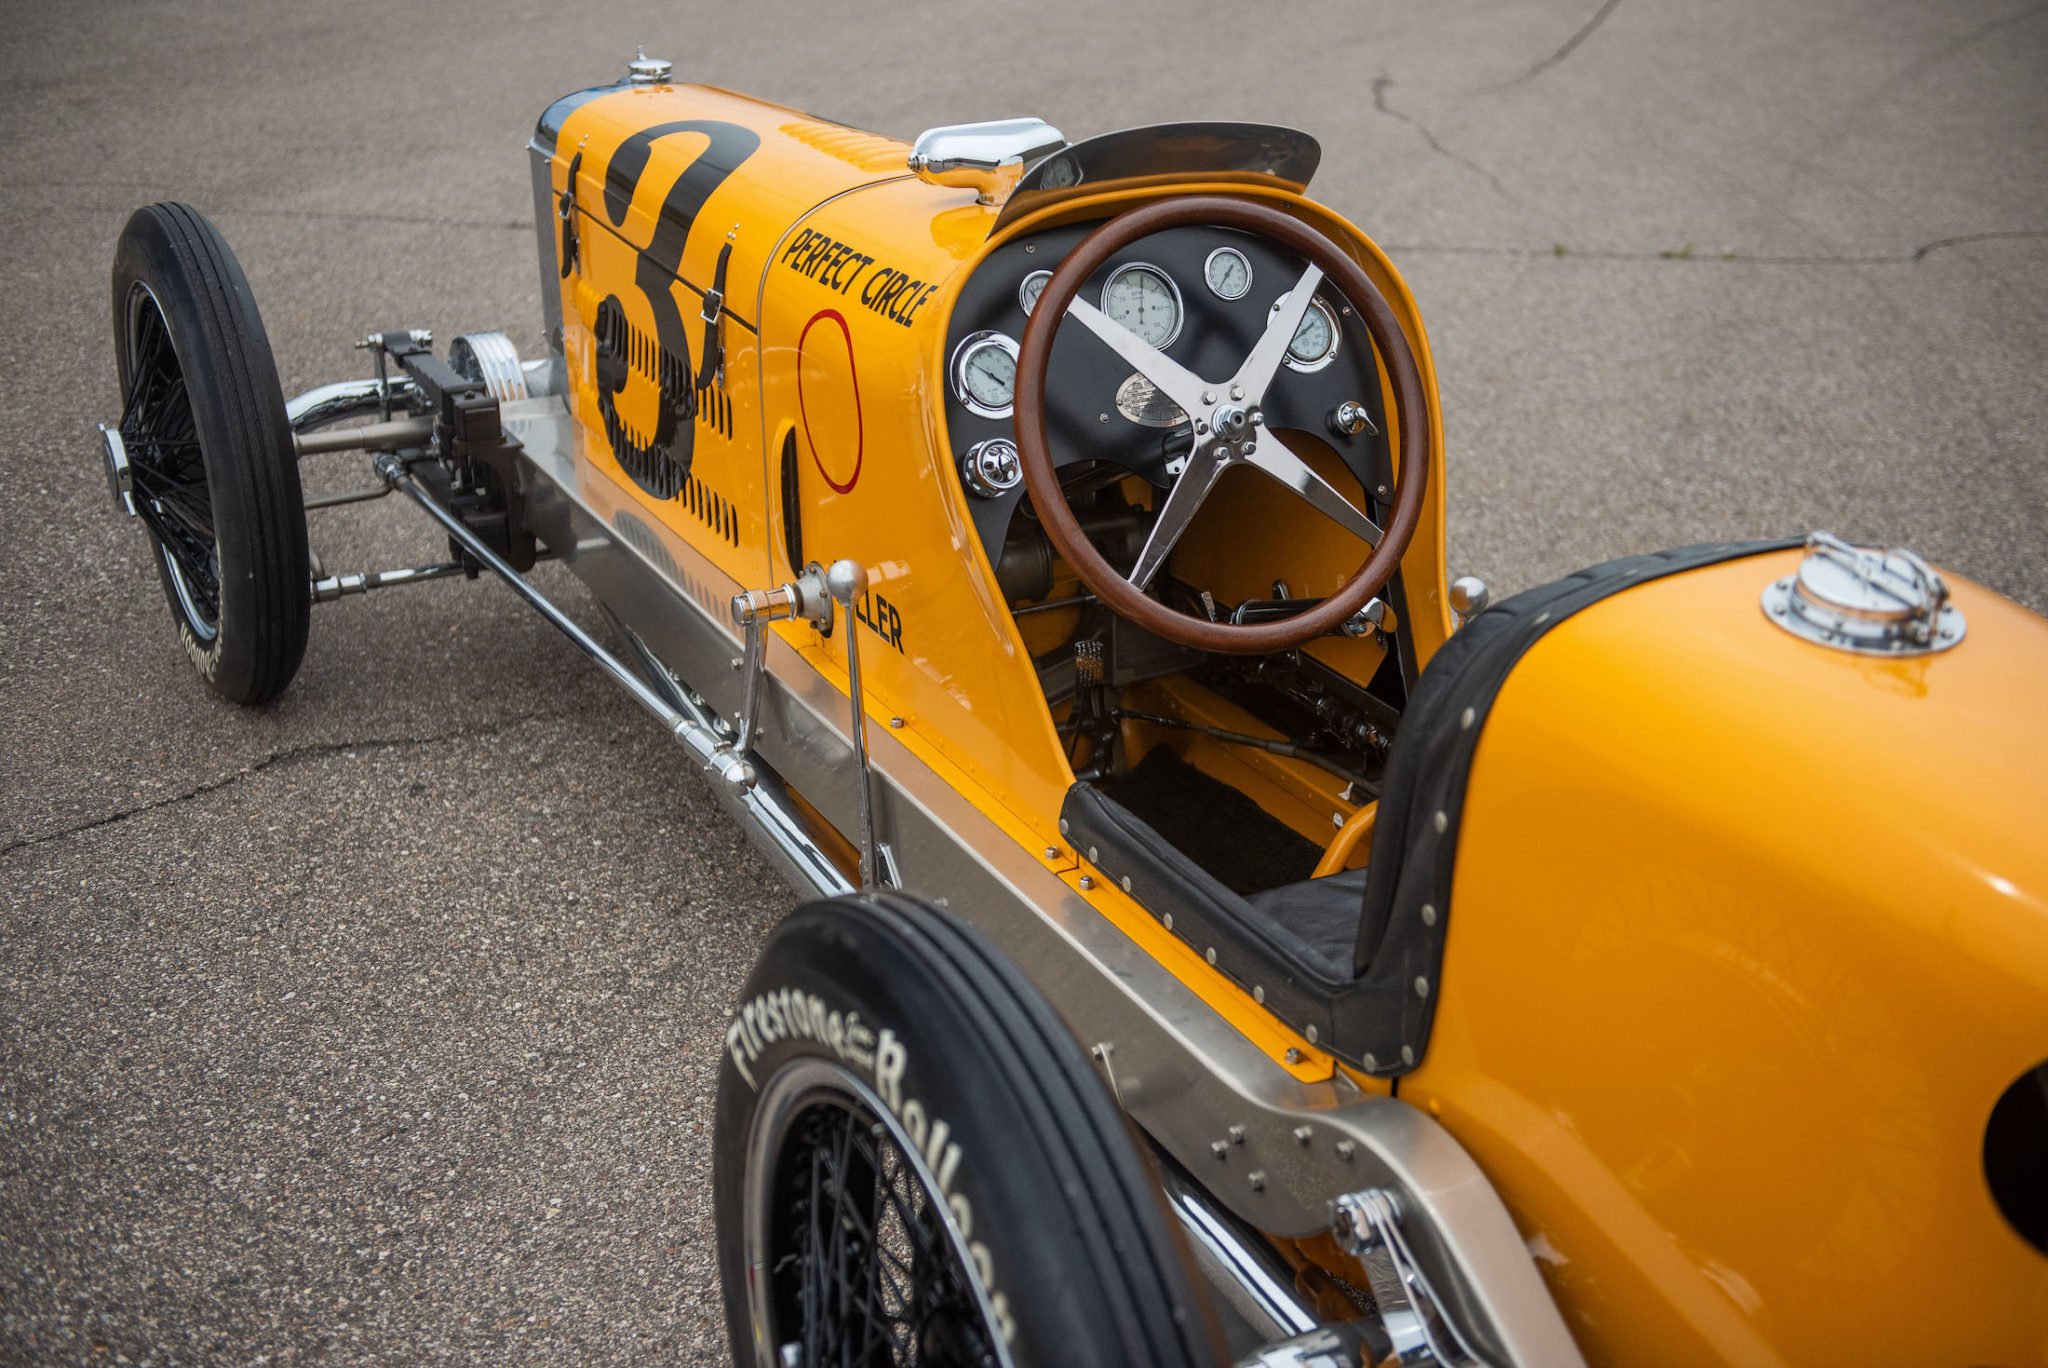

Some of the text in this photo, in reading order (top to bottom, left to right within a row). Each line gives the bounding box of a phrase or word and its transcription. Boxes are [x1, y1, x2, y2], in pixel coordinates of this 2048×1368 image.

[781, 227, 939, 328] PERFECT CIRCLE
[855, 587, 905, 656] LLER
[726, 985, 847, 1093] Firestone
